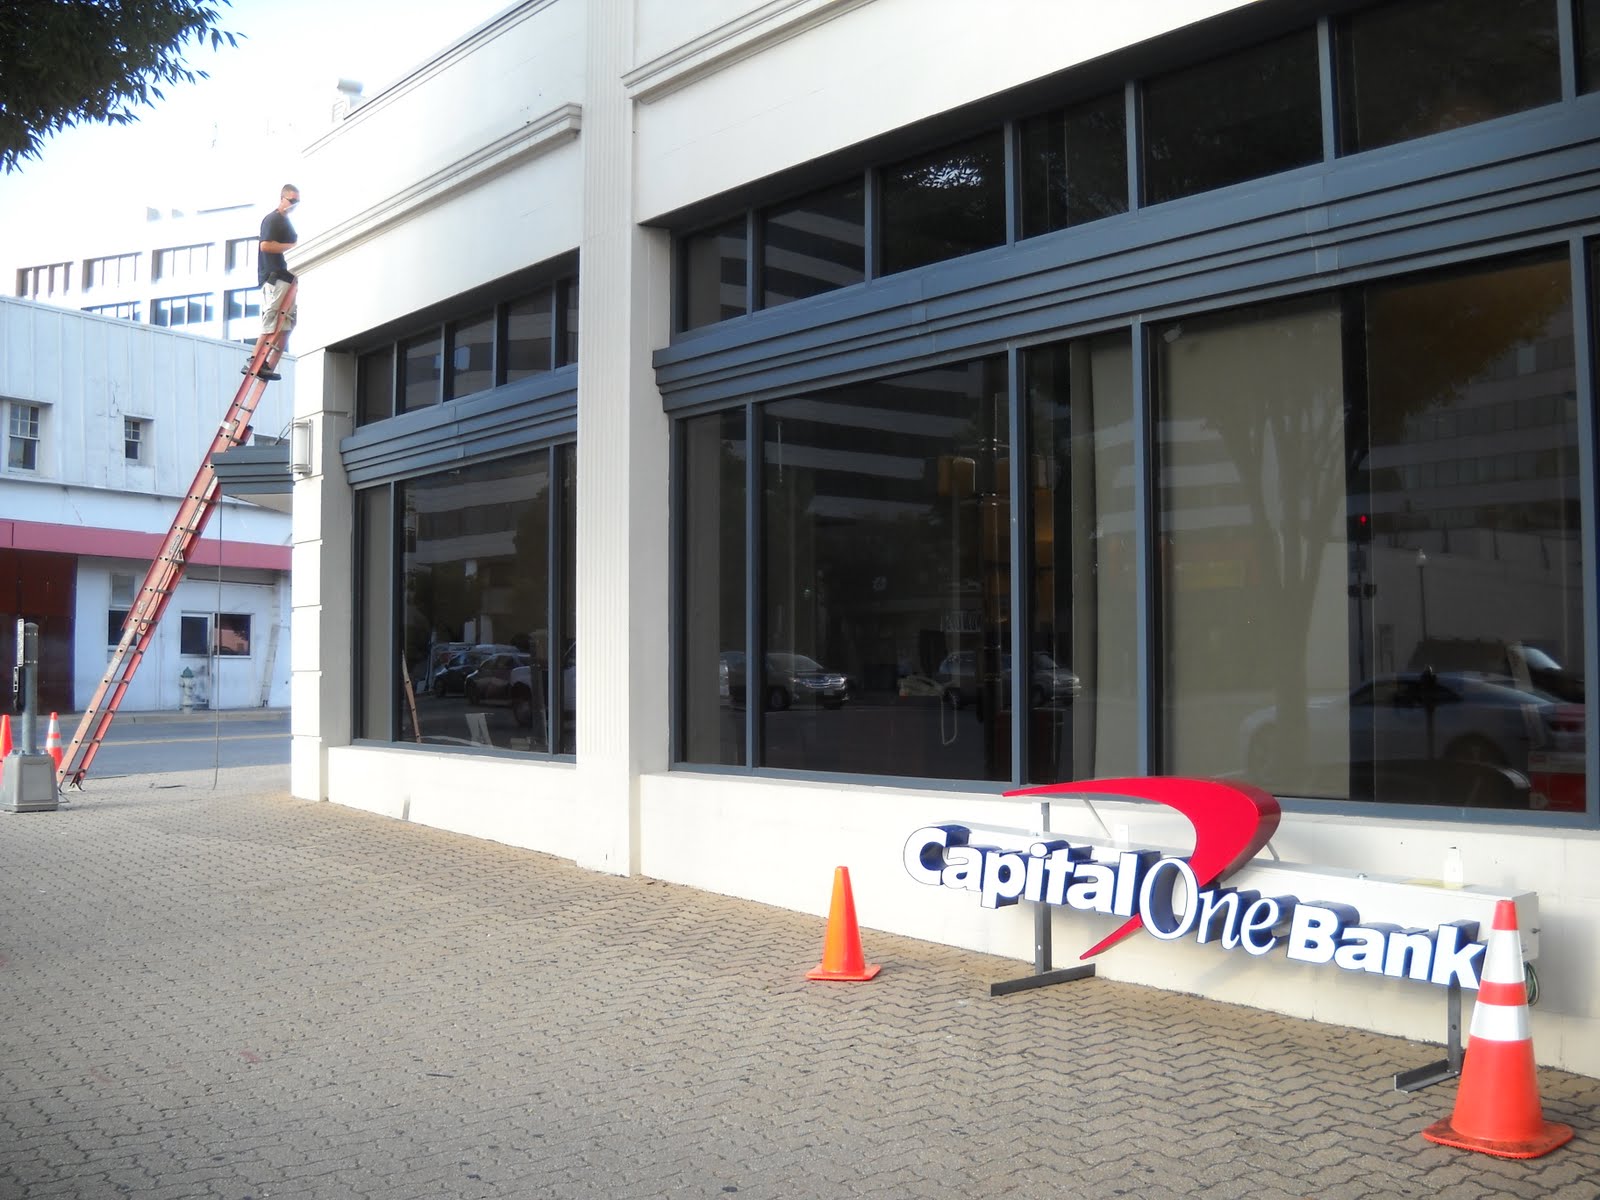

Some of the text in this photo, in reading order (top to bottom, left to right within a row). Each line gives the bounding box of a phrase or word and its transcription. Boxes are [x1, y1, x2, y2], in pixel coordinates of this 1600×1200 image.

[903, 825, 1487, 991] Capital One Bank
